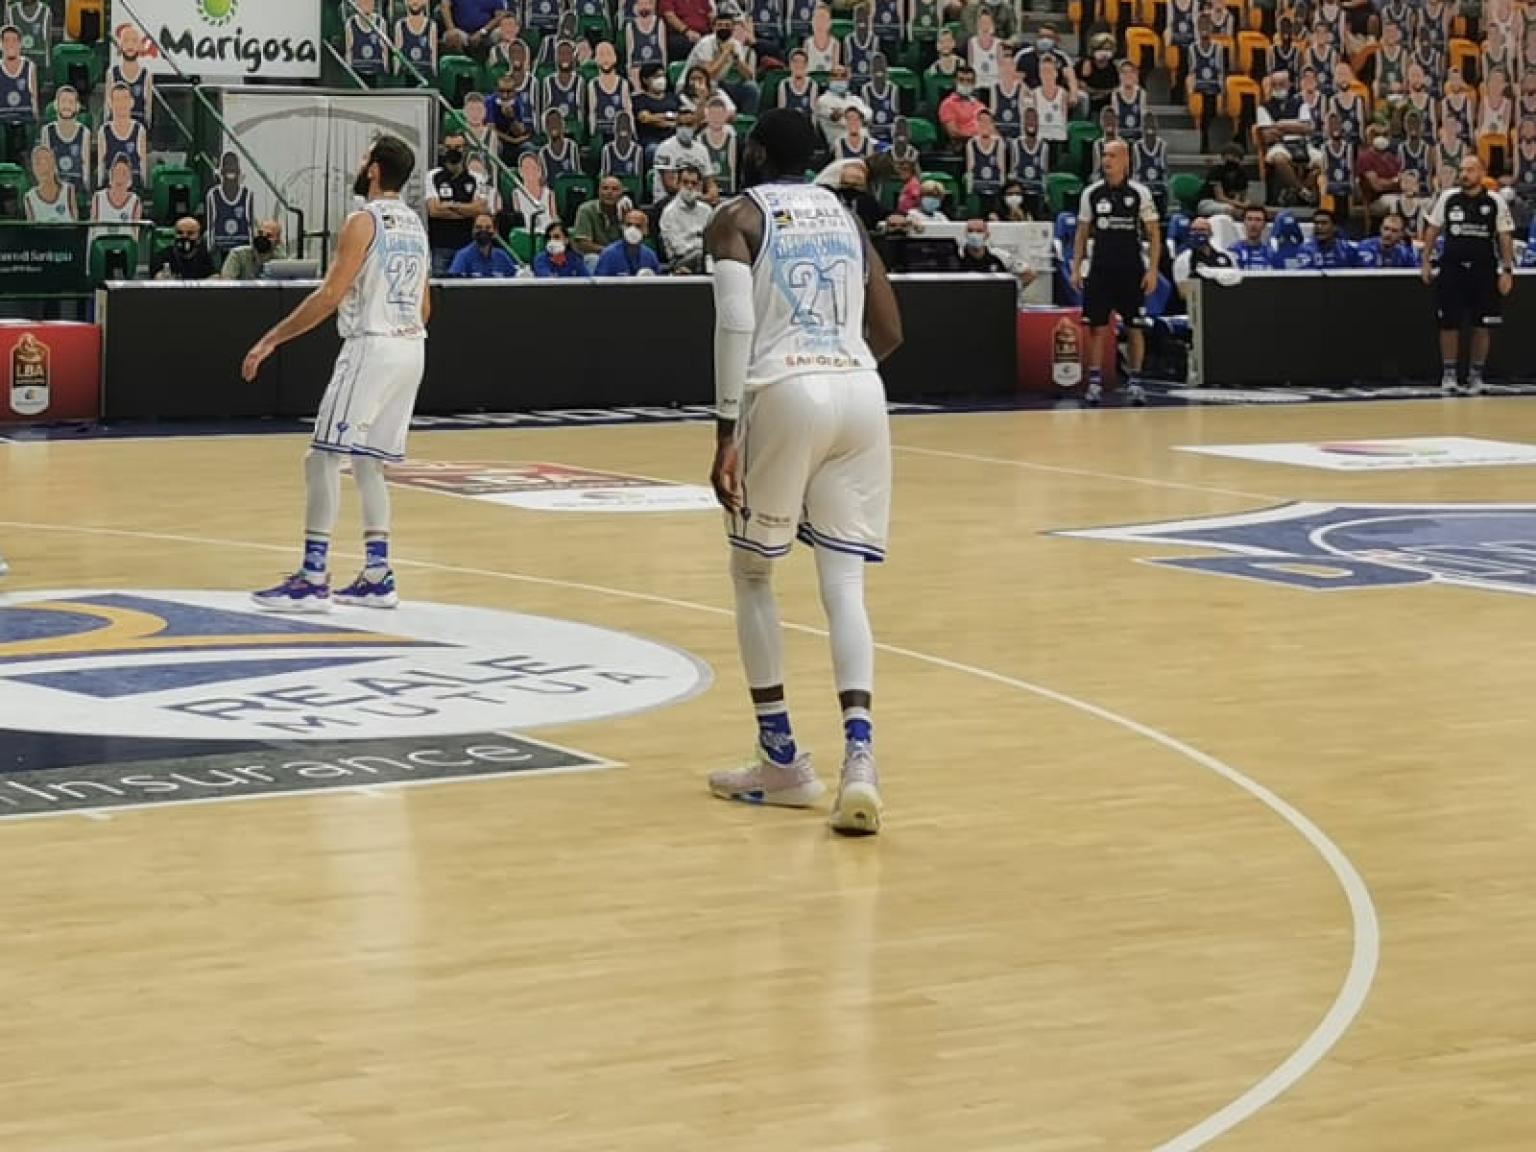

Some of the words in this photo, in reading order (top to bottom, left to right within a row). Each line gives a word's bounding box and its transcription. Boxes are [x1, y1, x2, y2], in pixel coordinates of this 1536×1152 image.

[159, 23, 318, 74] Marigosa
[386, 253, 421, 305] 22
[788, 258, 848, 327] 21
[163, 654, 596, 721] REALE
[254, 671, 670, 734] MUTUA
